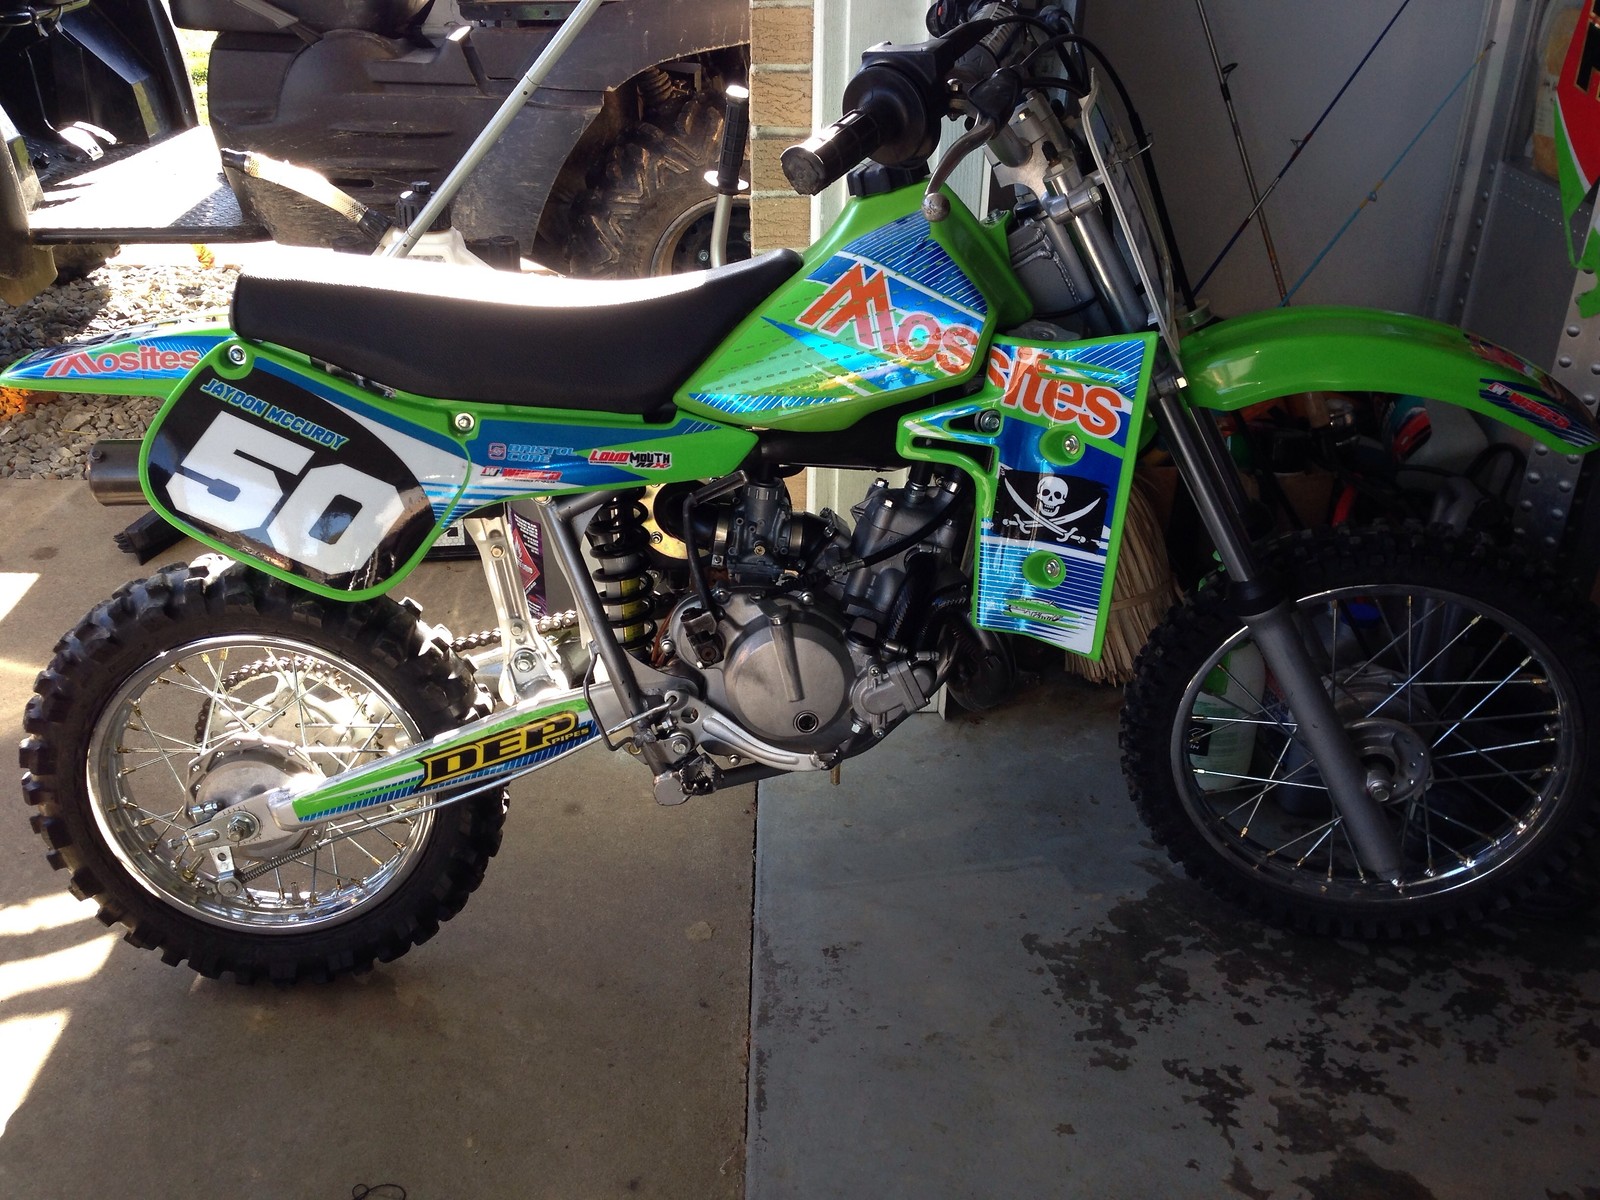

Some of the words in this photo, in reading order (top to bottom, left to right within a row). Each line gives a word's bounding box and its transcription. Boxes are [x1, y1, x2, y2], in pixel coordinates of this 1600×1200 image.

[45, 346, 200, 377] Mosites
[200, 378, 270, 417] JAYDON
[264, 405, 350, 450] MCCURDY
[506, 453, 552, 463] CORE
[507, 444, 577, 456] BRISTOL
[165, 410, 405, 575] 50
[426, 713, 577, 784] DEP
[551, 727, 589, 745] PIPES
